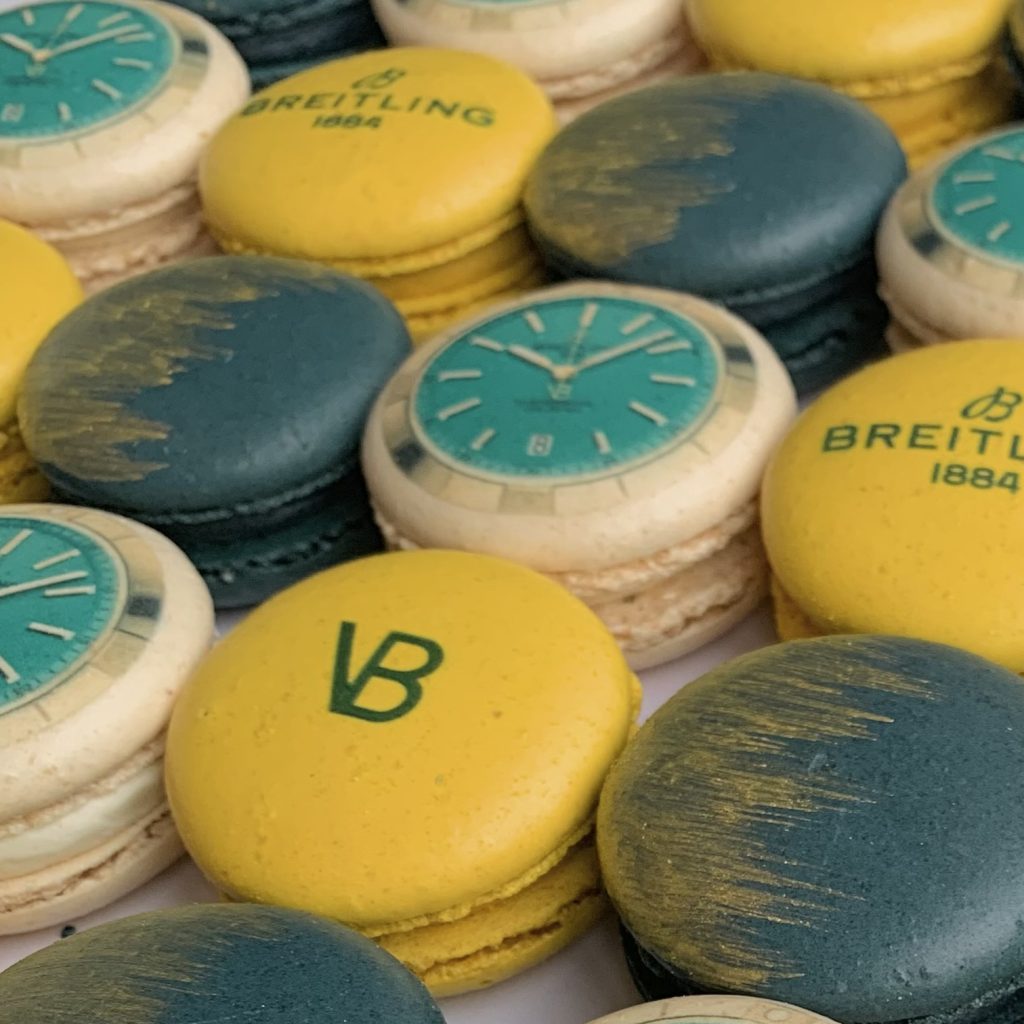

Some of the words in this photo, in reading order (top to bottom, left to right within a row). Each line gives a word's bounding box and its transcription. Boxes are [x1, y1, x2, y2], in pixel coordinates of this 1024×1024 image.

[241, 92, 495, 128] BREITLING
[311, 113, 382, 130] 1884
[930, 462, 1022, 495] 1884
[328, 620, 445, 723] VB
